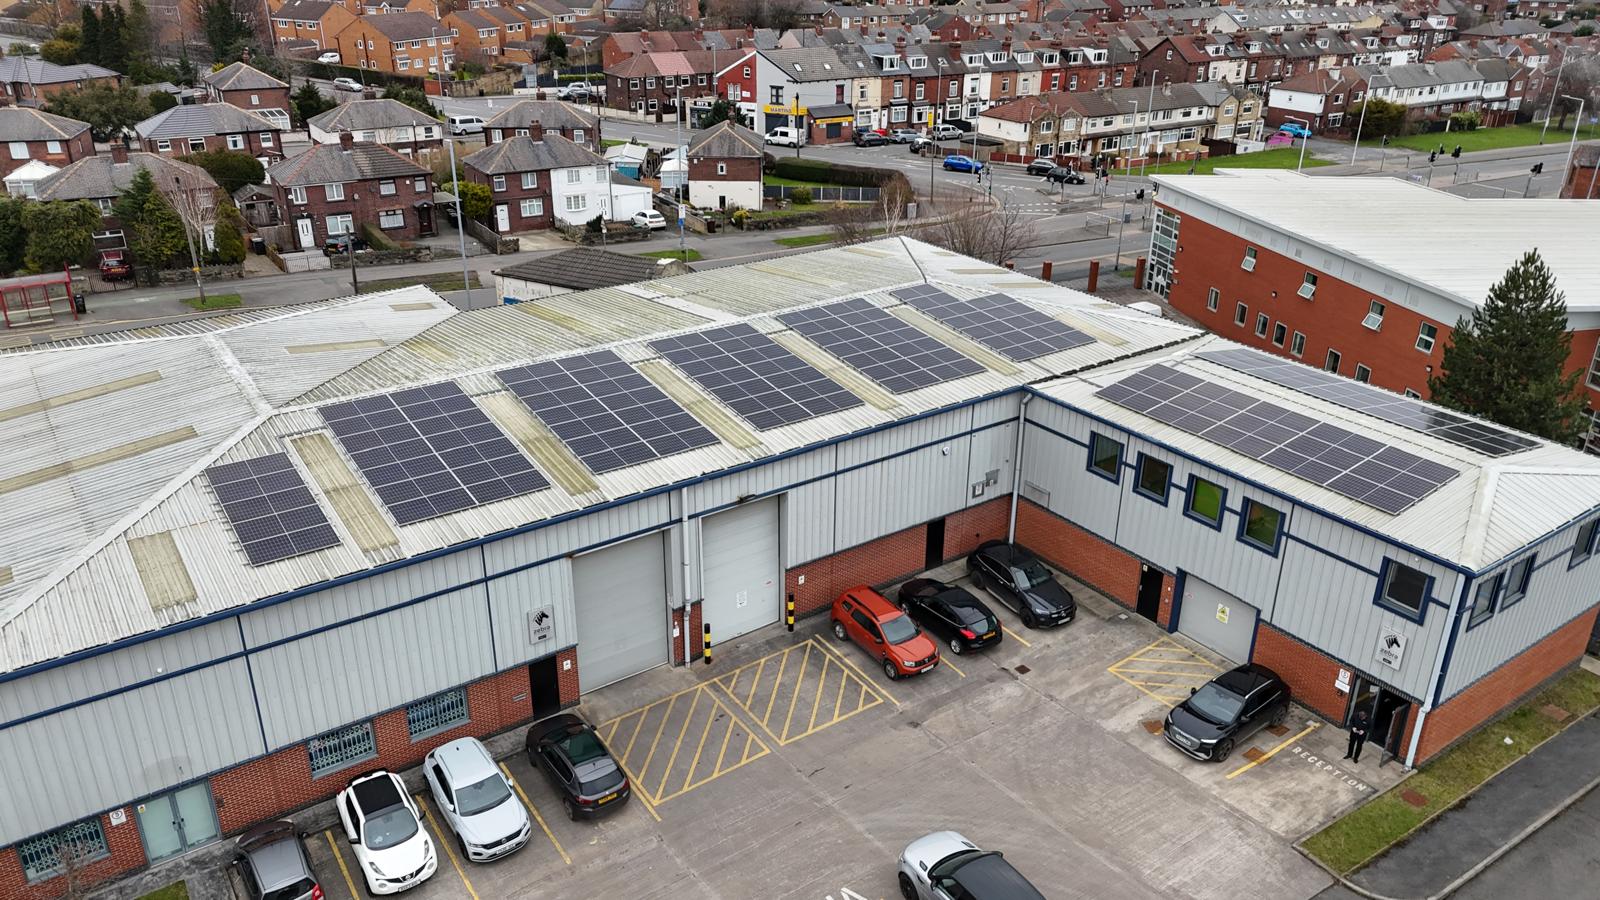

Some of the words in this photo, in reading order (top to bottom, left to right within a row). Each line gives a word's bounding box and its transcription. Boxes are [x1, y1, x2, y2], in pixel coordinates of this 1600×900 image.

[533, 625, 551, 635] zebra
[1380, 648, 1398, 660] zebra
[1292, 746, 1367, 791] RECEPTION
